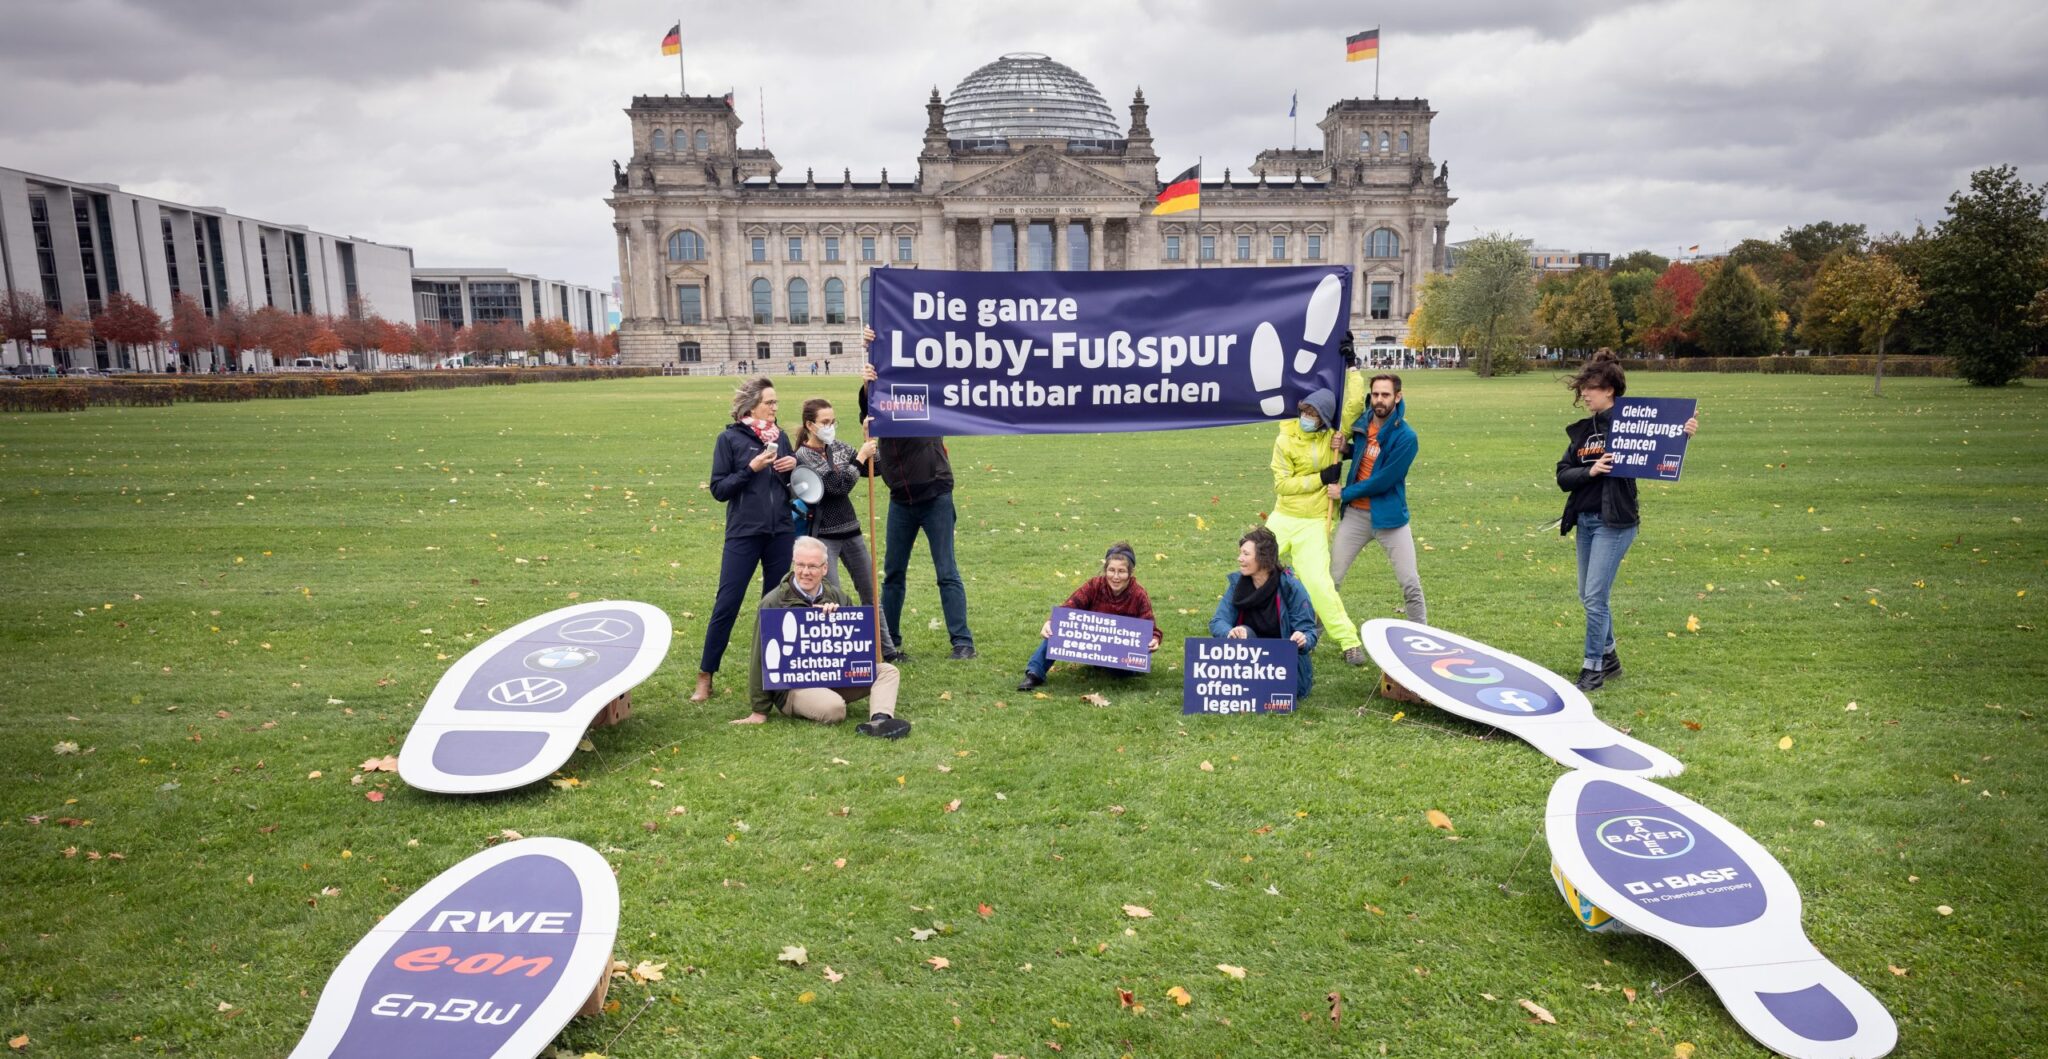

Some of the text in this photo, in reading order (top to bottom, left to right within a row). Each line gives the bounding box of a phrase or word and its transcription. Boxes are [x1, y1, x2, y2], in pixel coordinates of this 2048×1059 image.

[913, 291, 1078, 327] Die ganze
[891, 330, 1237, 376] Lobby-Fußspur
[894, 394, 926, 405] LOBBY
[943, 377, 1221, 407] sichtbar machen
[880, 400, 925, 412] CONTROL
[1622, 405, 1658, 418] Gleiche
[1611, 436, 1657, 451] chancen
[1611, 452, 1648, 466] für alle!
[805, 611, 864, 623] Die ganze
[1068, 611, 1117, 627] Schluss
[799, 622, 861, 640] Lobby-
[1059, 620, 1142, 638] mit heimlicher
[1058, 628, 1141, 648] Lobbyarbeit
[1062, 639, 1102, 651] gegen
[800, 639, 873, 655] Fußspur
[1049, 646, 1119, 663] Klimaschutz
[1199, 643, 1270, 664] Lobby-
[789, 657, 847, 669] sichtbar
[1193, 662, 1287, 680] Kontakte
[783, 670, 841, 683] machen!
[1196, 680, 1250, 696] offen-
[1203, 696, 1257, 714] legen!
[1606, 830, 1686, 843] BAYER
[1662, 867, 1739, 889] BASF
[1640, 882, 1753, 905] The Chemical Company
[427, 910, 573, 934] RWE
[370, 993, 522, 1026] EnBW
